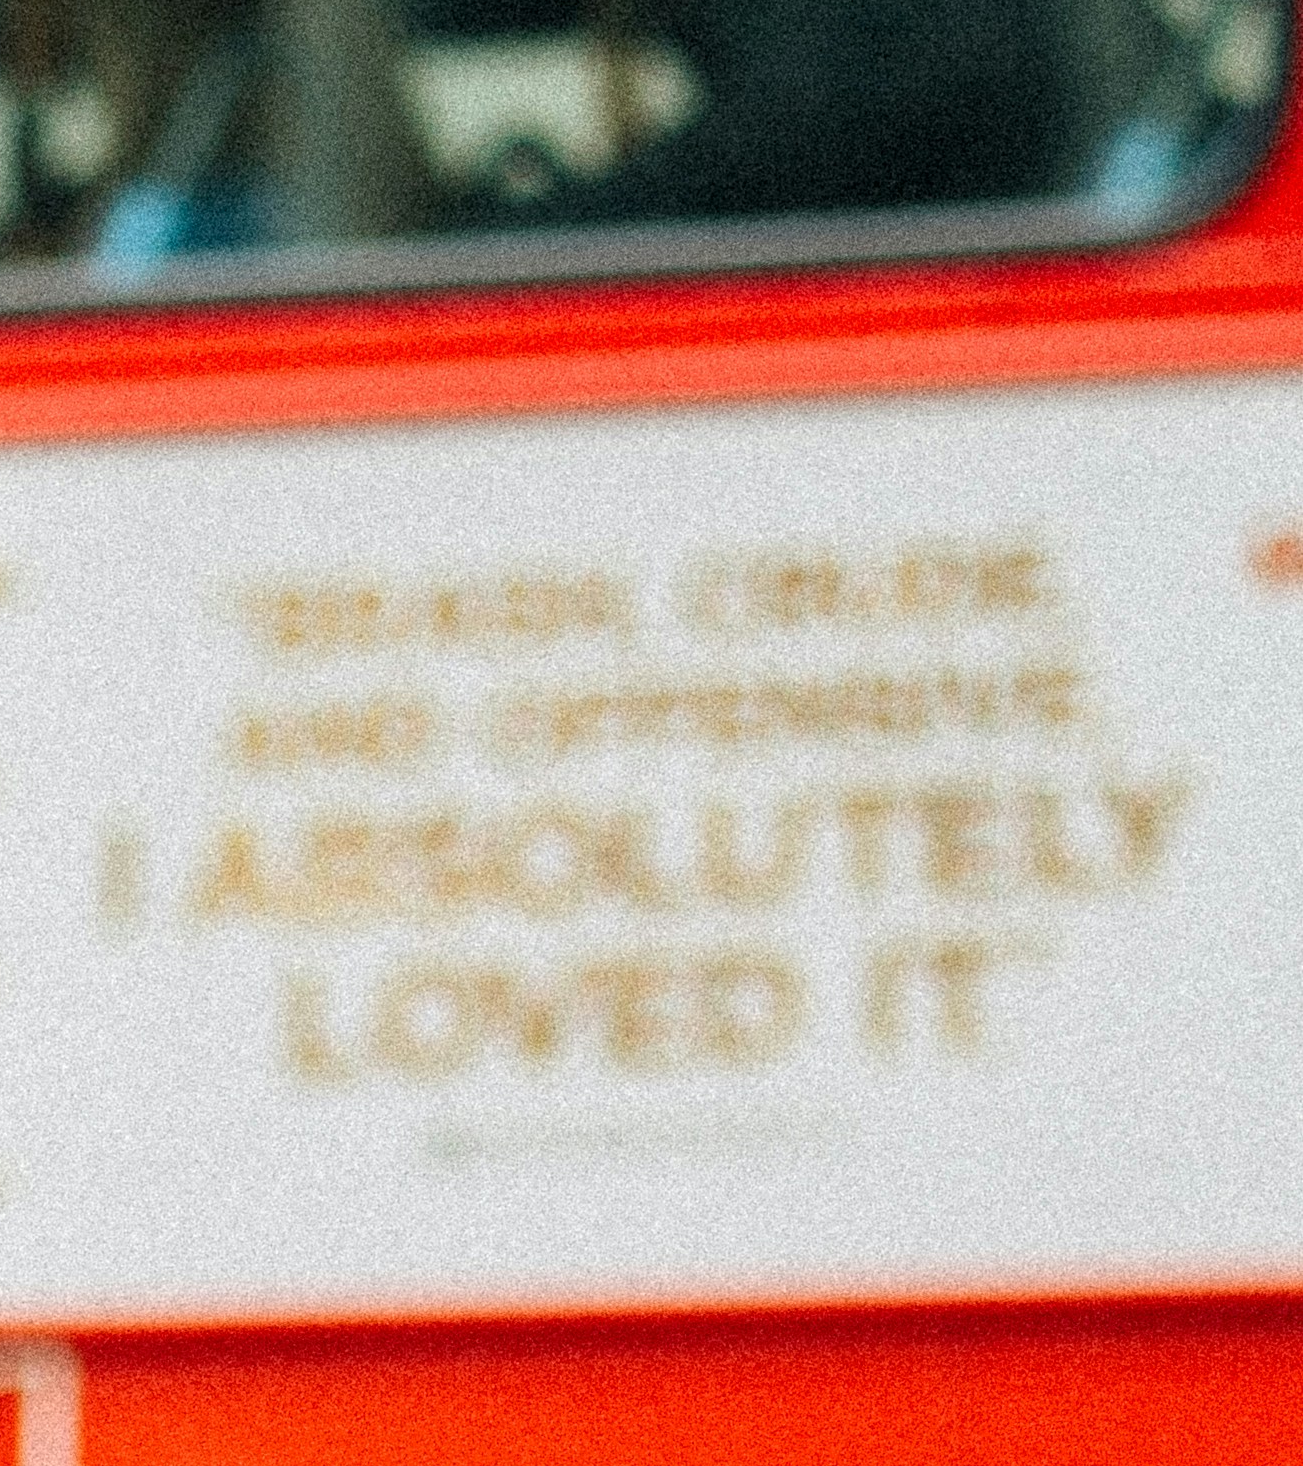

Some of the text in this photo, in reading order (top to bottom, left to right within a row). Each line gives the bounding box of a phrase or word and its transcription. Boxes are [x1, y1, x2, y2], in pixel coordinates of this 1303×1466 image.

[226, 684, 435, 772] AND
[95, 770, 1193, 928] I ABSOLUTELY
[269, 944, 816, 1092] LOVED
